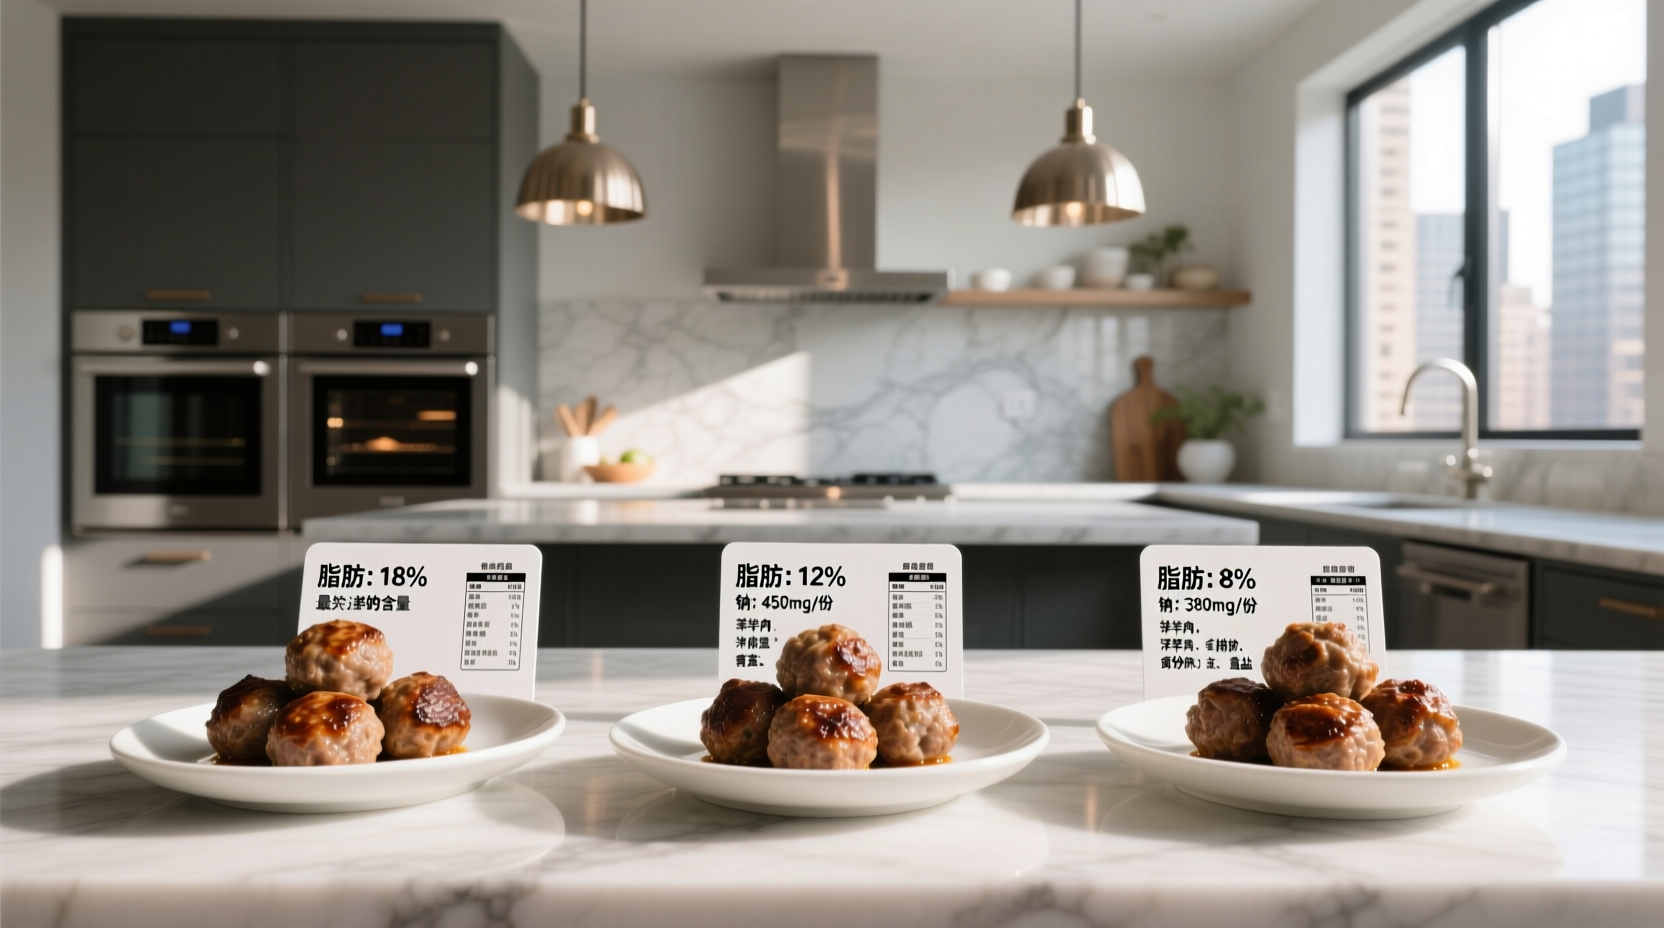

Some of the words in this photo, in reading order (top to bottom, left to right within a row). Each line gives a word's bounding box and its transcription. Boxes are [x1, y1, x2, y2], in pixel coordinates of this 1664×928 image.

[380, 565, 428, 588] 18%
[798, 565, 846, 587] 12%
[1219, 567, 1257, 590] 8%
